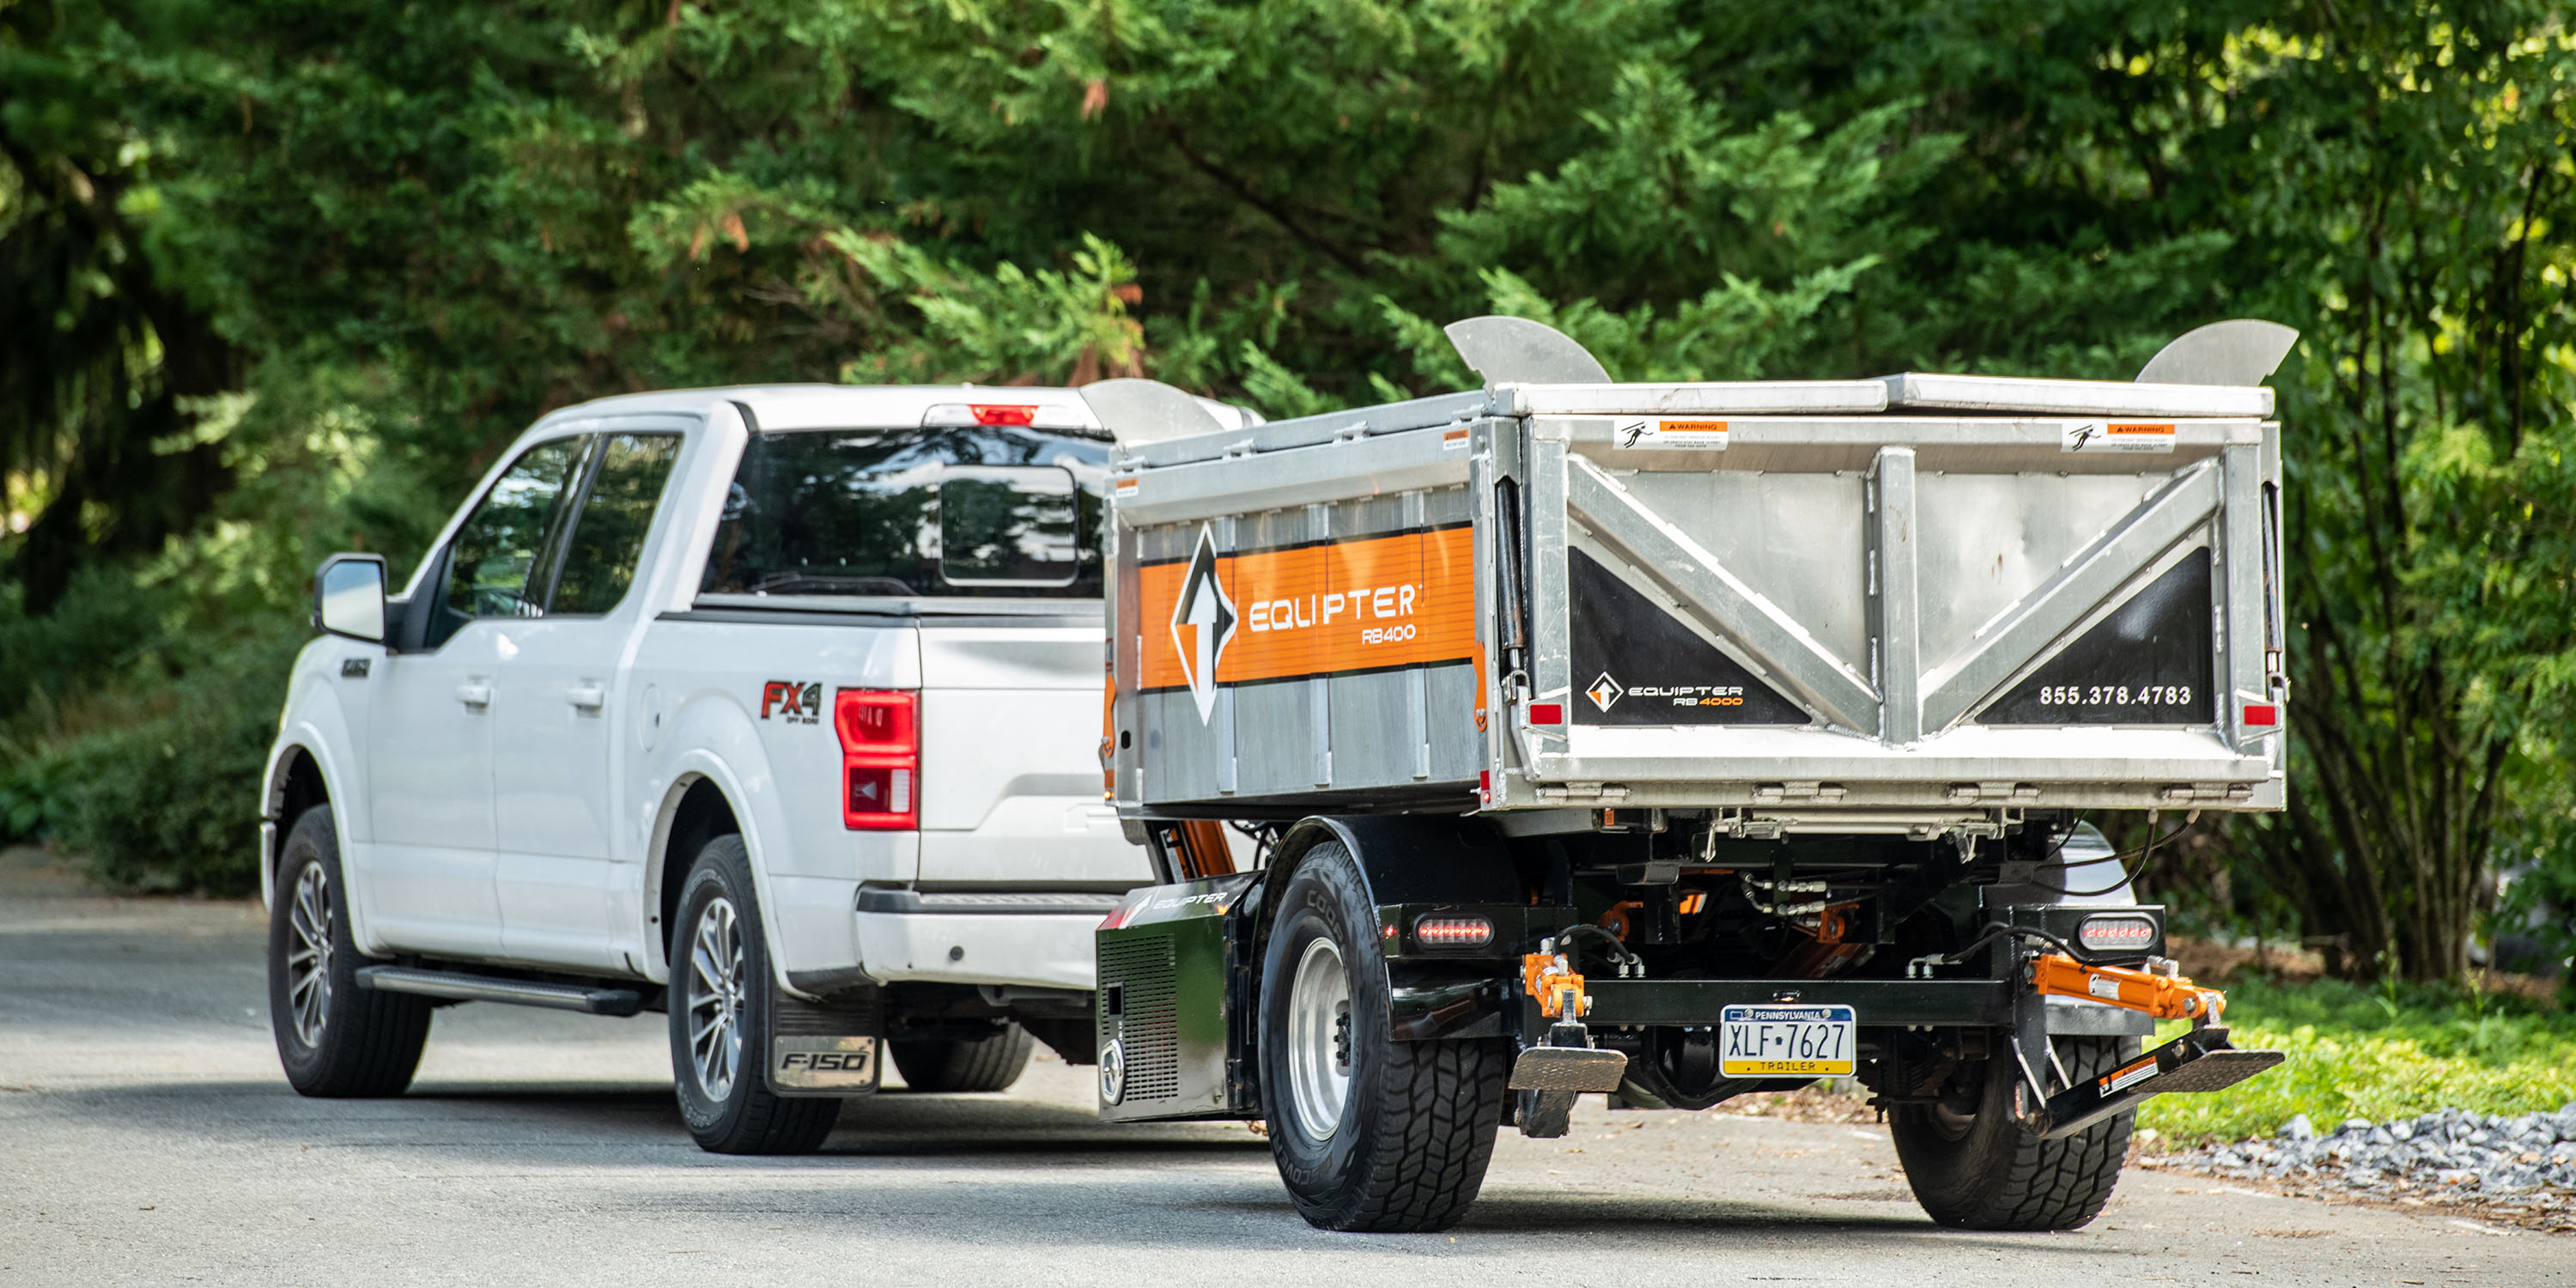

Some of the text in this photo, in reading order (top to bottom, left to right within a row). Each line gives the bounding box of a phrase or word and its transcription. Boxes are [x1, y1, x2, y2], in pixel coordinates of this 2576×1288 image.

[761, 679, 822, 720] FX4
[1628, 686, 1743, 697] EQUIPTER
[2039, 685, 2191, 705] 855.378.4783
[1673, 697, 1743, 707] RB4000
[1153, 892, 1228, 909] EQUIPTER
[1755, 1011, 1820, 1020] PENNSYLVANIA
[1728, 1024, 1844, 1059] XLF 7627
[781, 1053, 867, 1071] F-150
[1760, 1061, 1815, 1071] TRAILER
